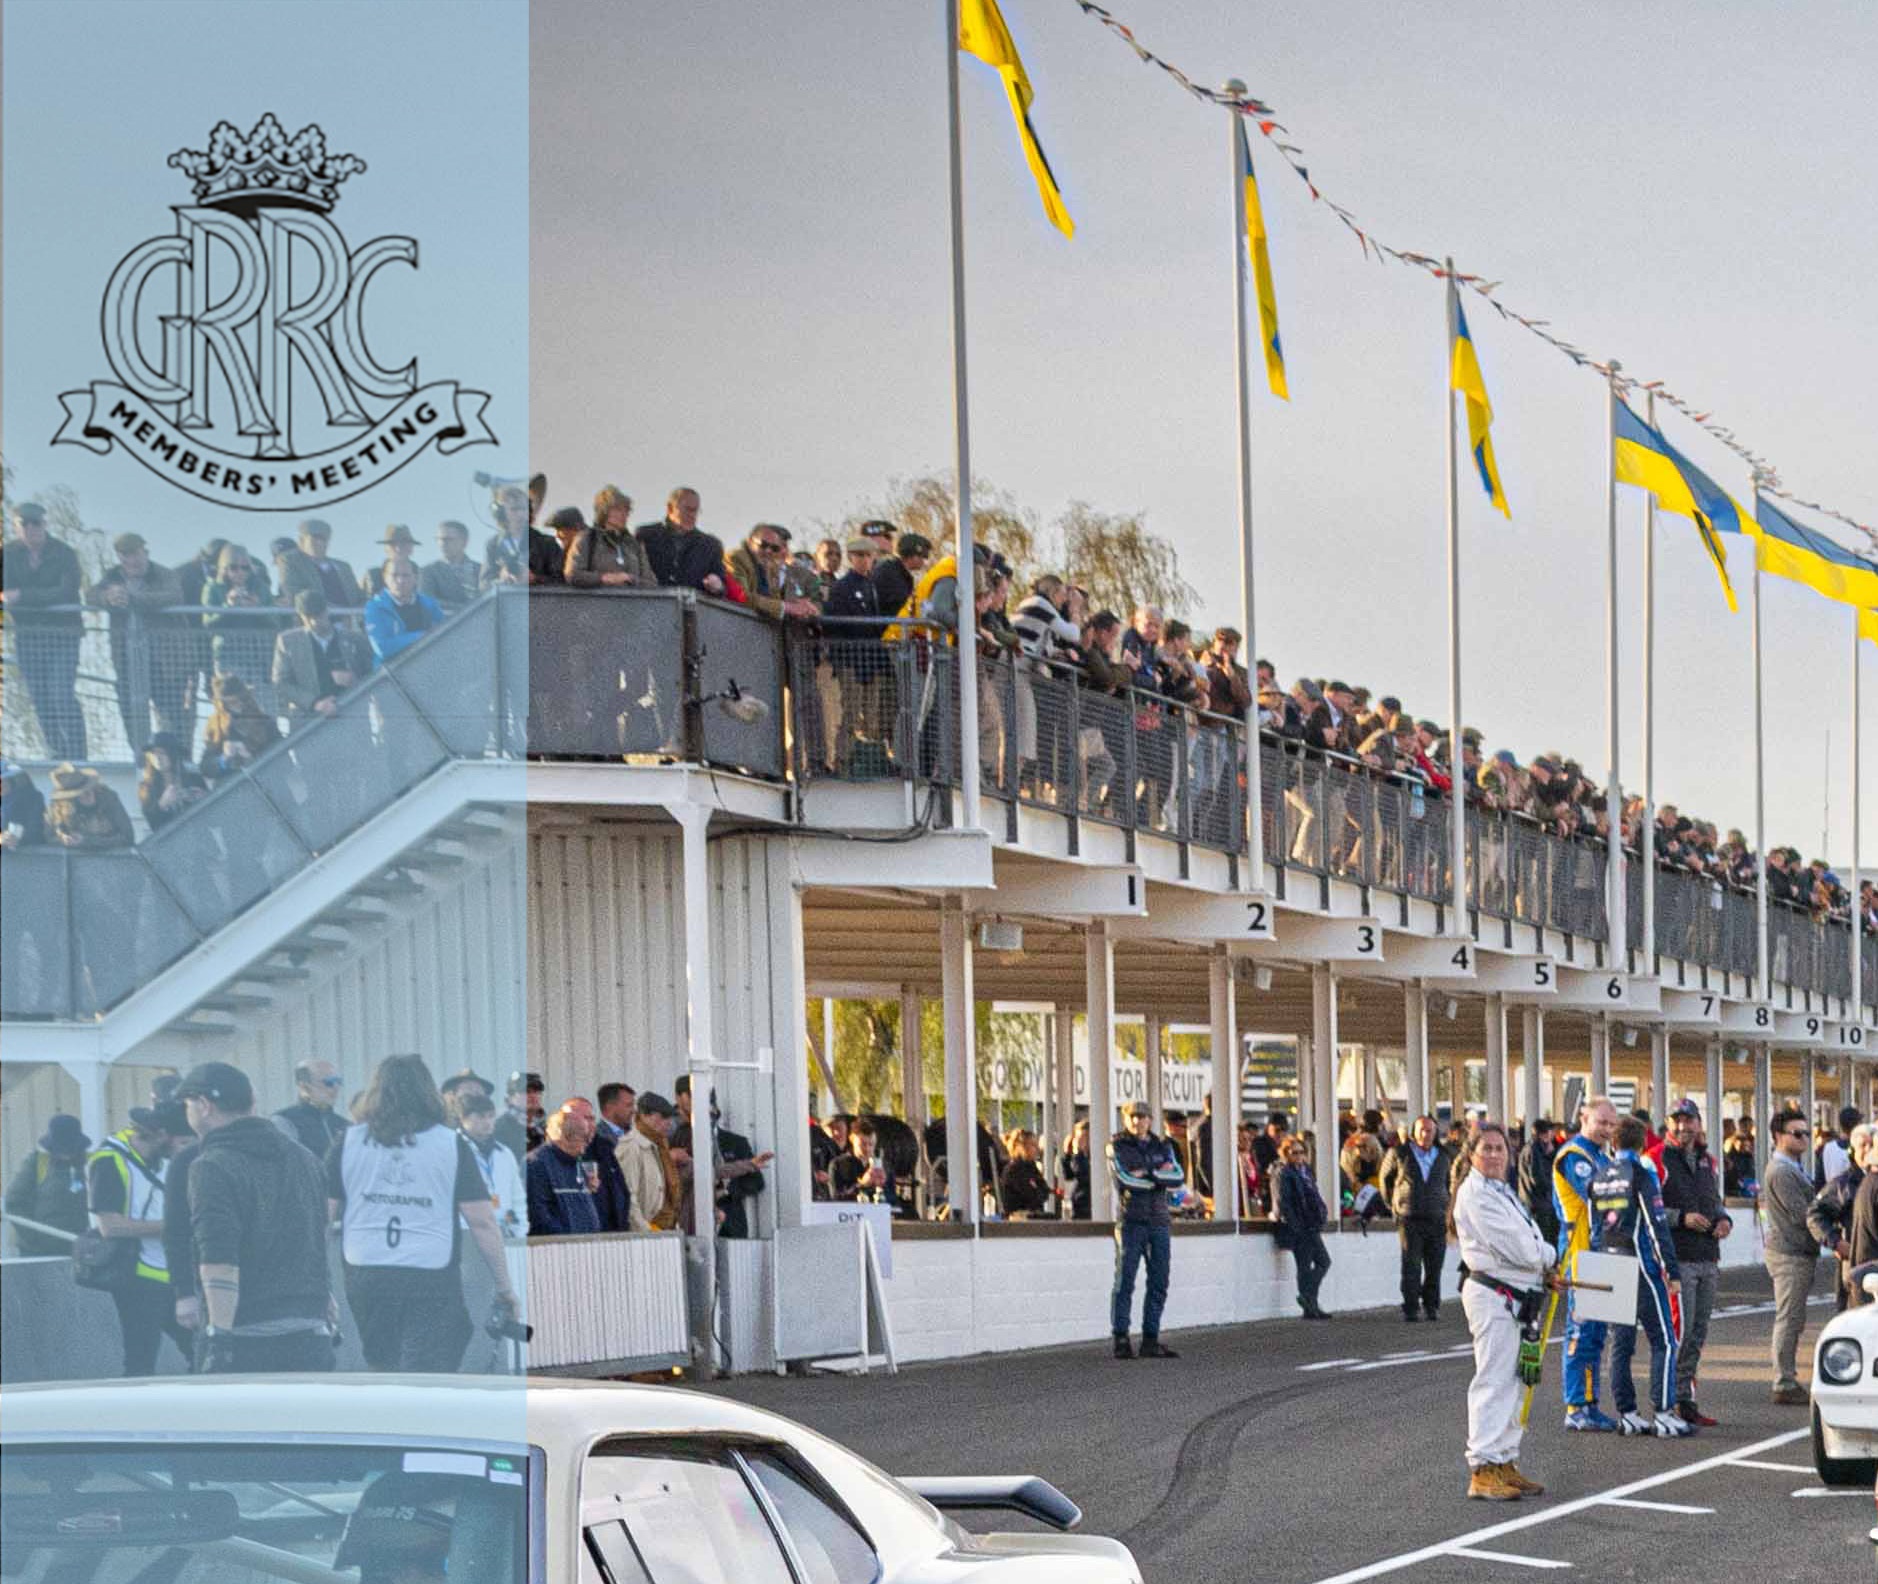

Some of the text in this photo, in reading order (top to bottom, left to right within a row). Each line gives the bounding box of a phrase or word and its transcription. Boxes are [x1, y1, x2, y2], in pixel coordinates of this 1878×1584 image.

[1127, 875, 1136, 906] 1
[1247, 903, 1267, 932] 2
[1357, 925, 1375, 952] 3
[1451, 945, 1469, 970] 4
[1534, 961, 1549, 985] 5
[1606, 976, 1621, 999] 6
[1701, 996, 1713, 1016] 7
[1756, 1007, 1769, 1026] 8
[1807, 1018, 1819, 1036] 9
[1840, 1026, 1862, 1045] 10
[979, 1060, 1204, 1102] GOODWD TOR RCUIT
[386, 1215, 402, 1249] 6
